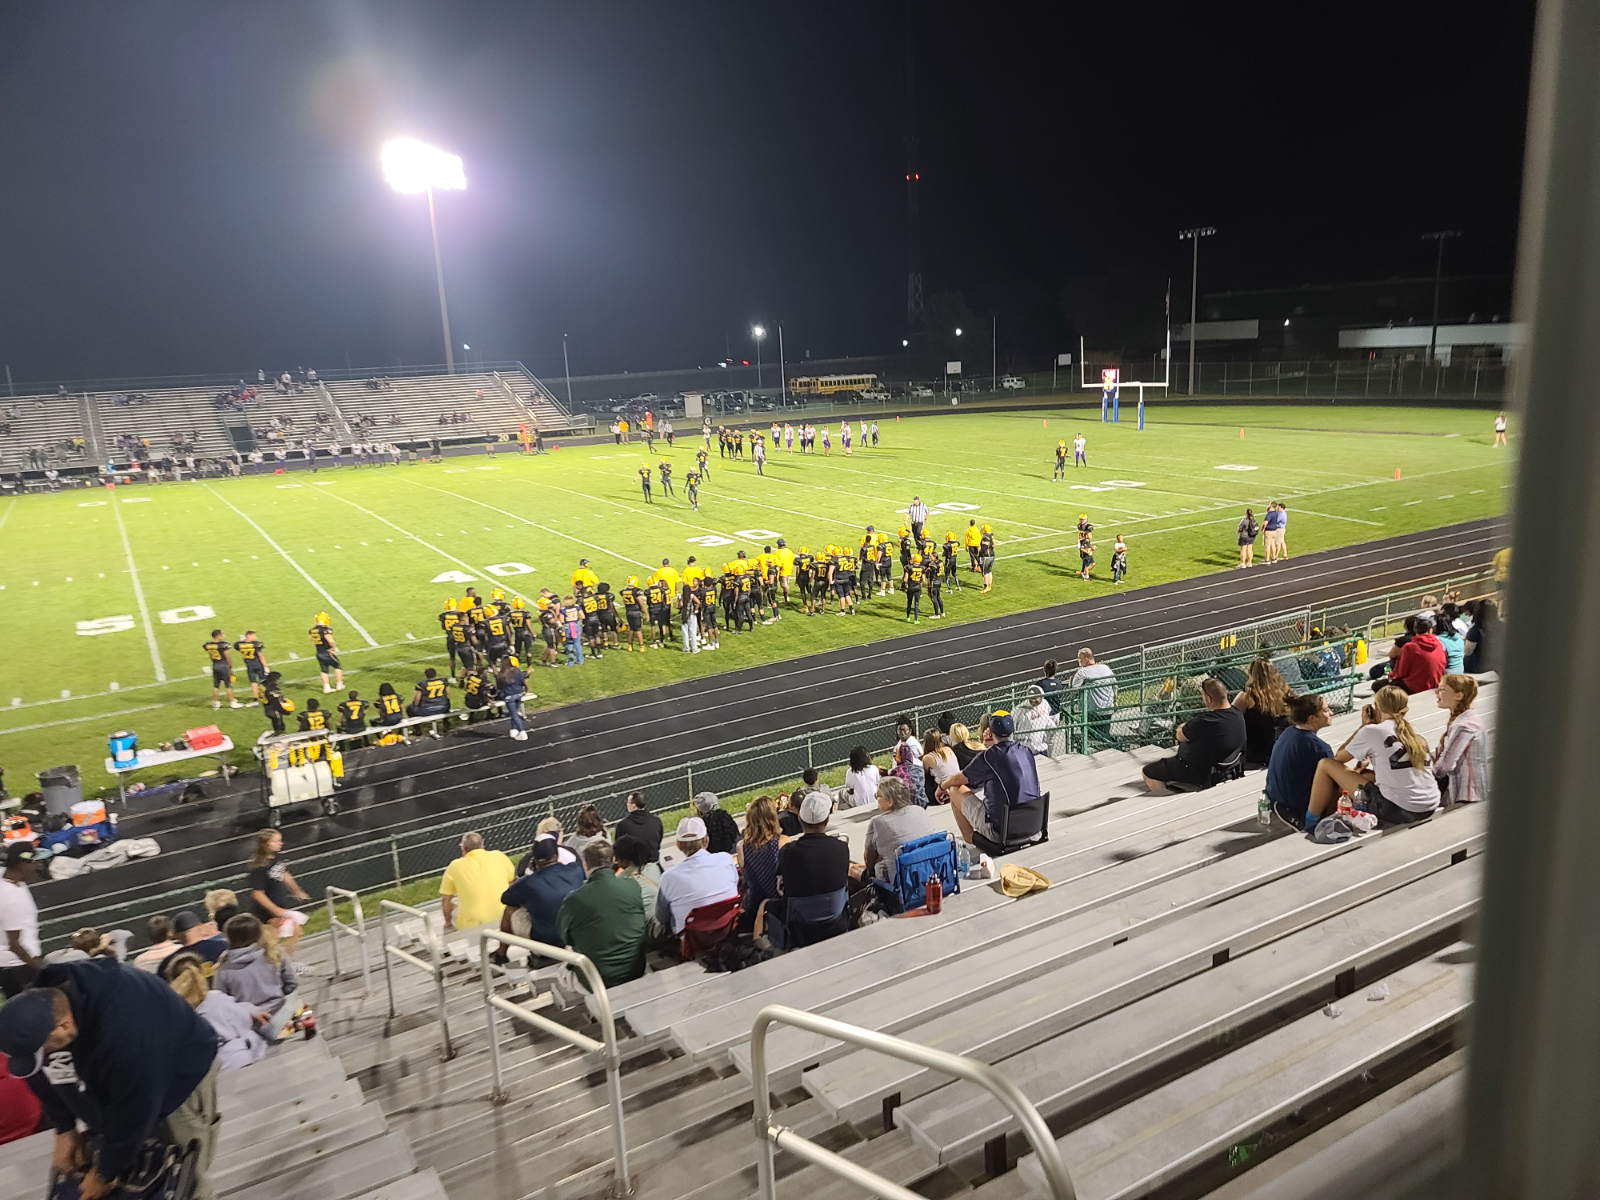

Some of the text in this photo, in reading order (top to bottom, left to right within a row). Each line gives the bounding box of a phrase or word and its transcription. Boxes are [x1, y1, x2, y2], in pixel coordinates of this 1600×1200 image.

[685, 529, 784, 547] 30
[430, 562, 537, 583] 40
[910, 571, 922, 581] 42
[650, 592, 662, 603] 24
[76, 605, 217, 636] 50
[489, 624, 504, 636] 51
[427, 684, 445, 699] 77
[350, 705, 362, 720] 7
[384, 700, 401, 714] 14
[309, 716, 325, 730] 12
